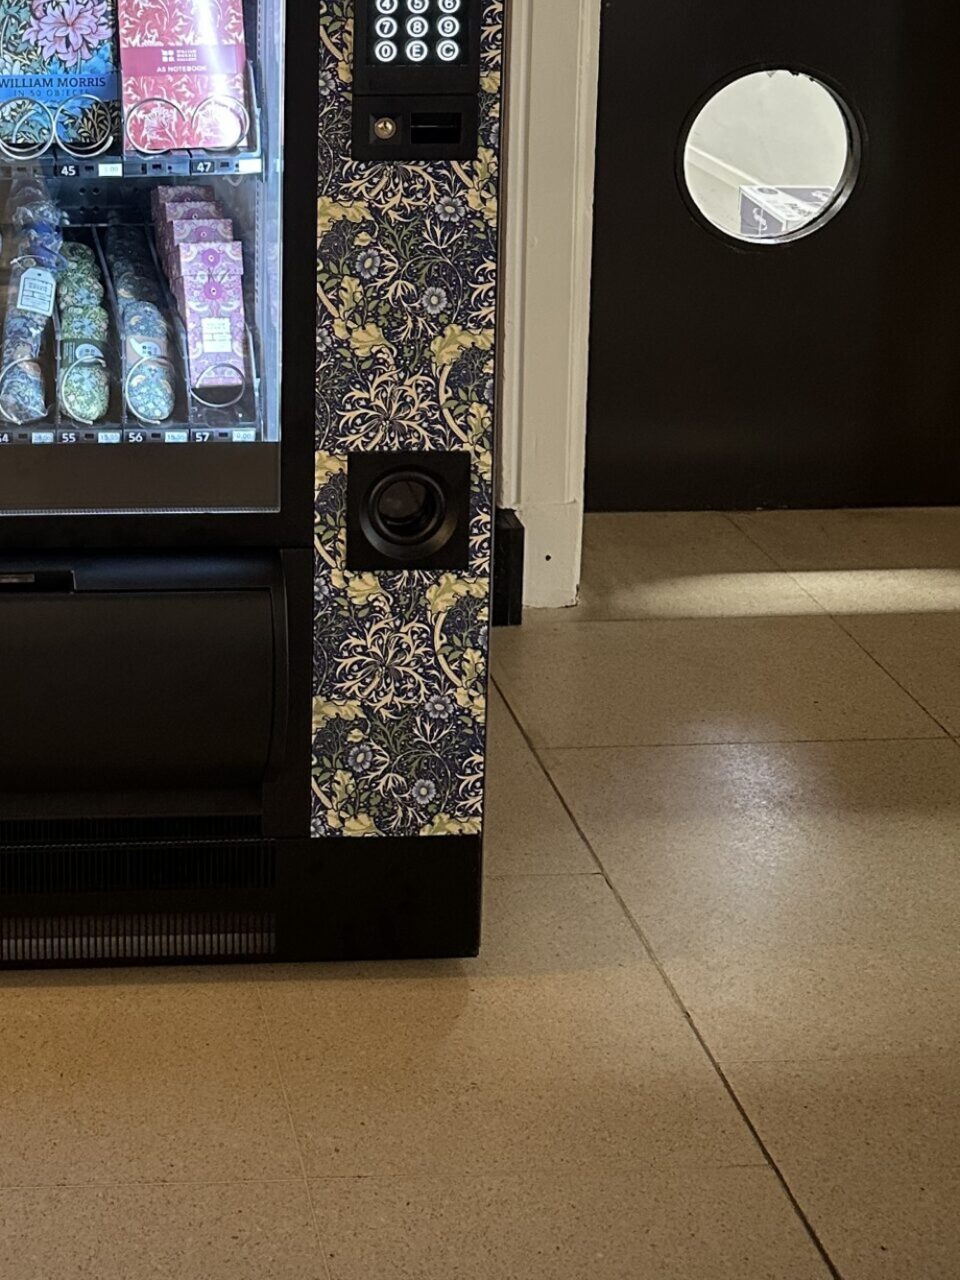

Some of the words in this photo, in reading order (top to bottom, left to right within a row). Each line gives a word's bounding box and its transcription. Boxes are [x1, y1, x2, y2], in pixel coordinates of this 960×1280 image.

[382, 22, 390, 34] 7
[413, 22, 421, 33] 8
[444, 21, 452, 32] 9
[382, 45, 390, 56] 0
[413, 45, 421, 56] E
[444, 44, 452, 56] C
[58, 76, 106, 88] MORRIS
[14, 89, 24, 97] IN
[30, 89, 41, 97] 50
[60, 165, 76, 176] 45
[196, 162, 212, 172] 47
[62, 432, 76, 442] 55
[128, 432, 143, 442] 56
[194, 432, 210, 442] 57
